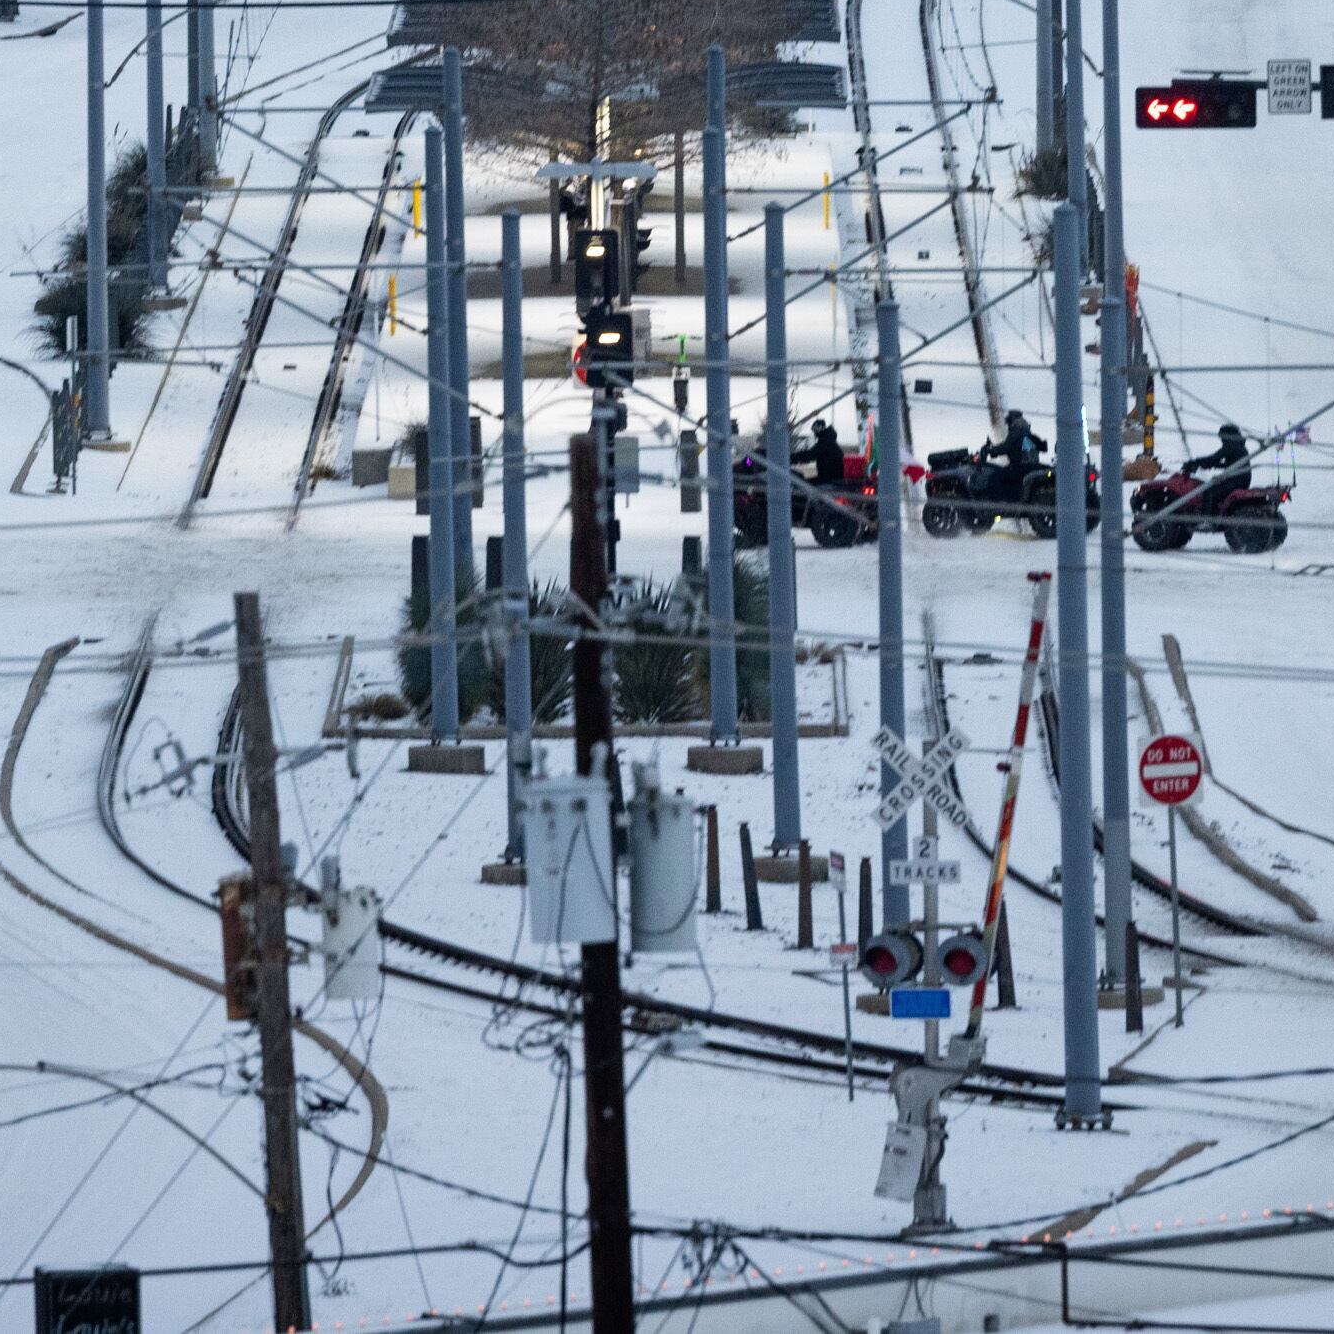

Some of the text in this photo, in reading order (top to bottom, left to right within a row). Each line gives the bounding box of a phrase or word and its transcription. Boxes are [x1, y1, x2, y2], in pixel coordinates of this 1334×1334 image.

[1274, 76, 1306, 85] GREEN
[1273, 88, 1307, 97] ARROW
[1277, 100, 1303, 108] ONLY
[1147, 746, 1191, 762] DO NOT
[1153, 777, 1189, 794] ENTER
[919, 839, 931, 858] 2
[894, 866, 958, 880] TRACKS
